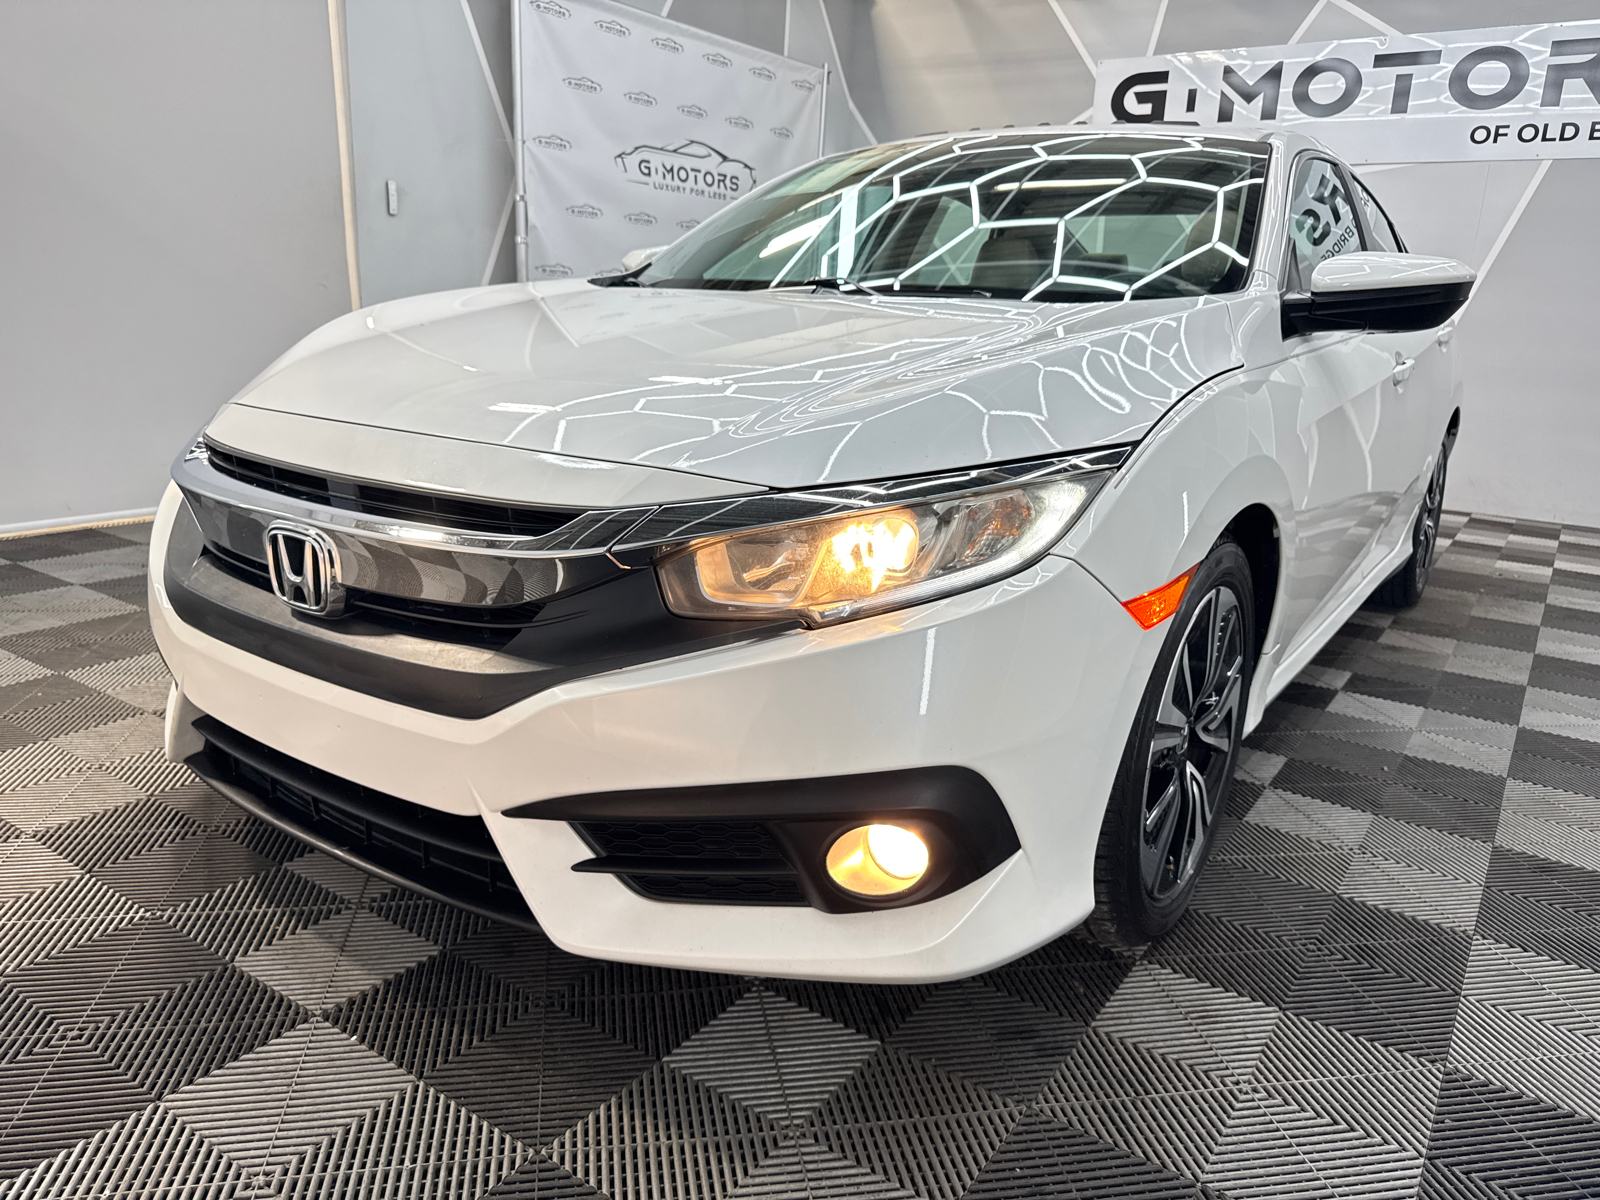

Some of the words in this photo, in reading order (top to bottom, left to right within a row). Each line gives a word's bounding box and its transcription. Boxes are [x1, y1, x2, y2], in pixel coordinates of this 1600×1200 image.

[1470, 124, 1511, 145] OF
[1517, 122, 1580, 144] OLD
[662, 162, 740, 193] MOTORS
[653, 181, 686, 194] LUXURY
[690, 187, 706, 198] FOR
[708, 191, 727, 201] LESS
